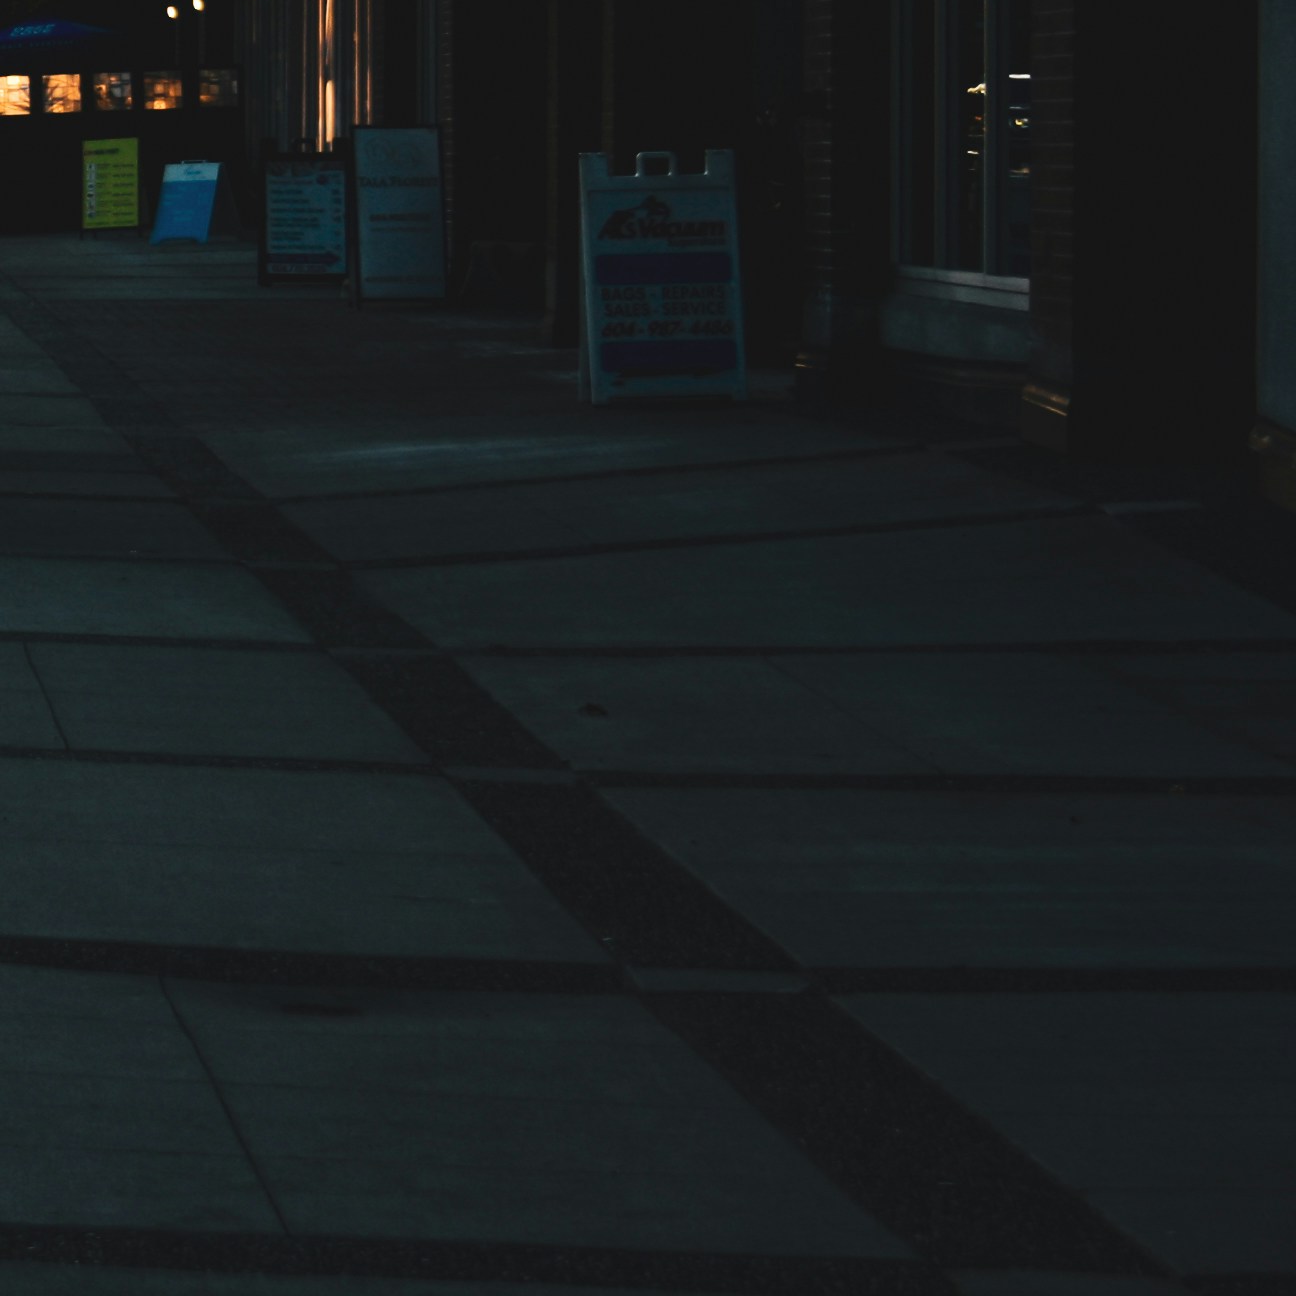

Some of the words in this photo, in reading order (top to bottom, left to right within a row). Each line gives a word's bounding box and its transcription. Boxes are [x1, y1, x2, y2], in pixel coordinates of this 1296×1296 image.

[601, 287, 646, 301] BAGS
[661, 285, 726, 300] REPAIRS
[604, 303, 650, 317] SALES
[661, 301, 726, 316] SERVICE
